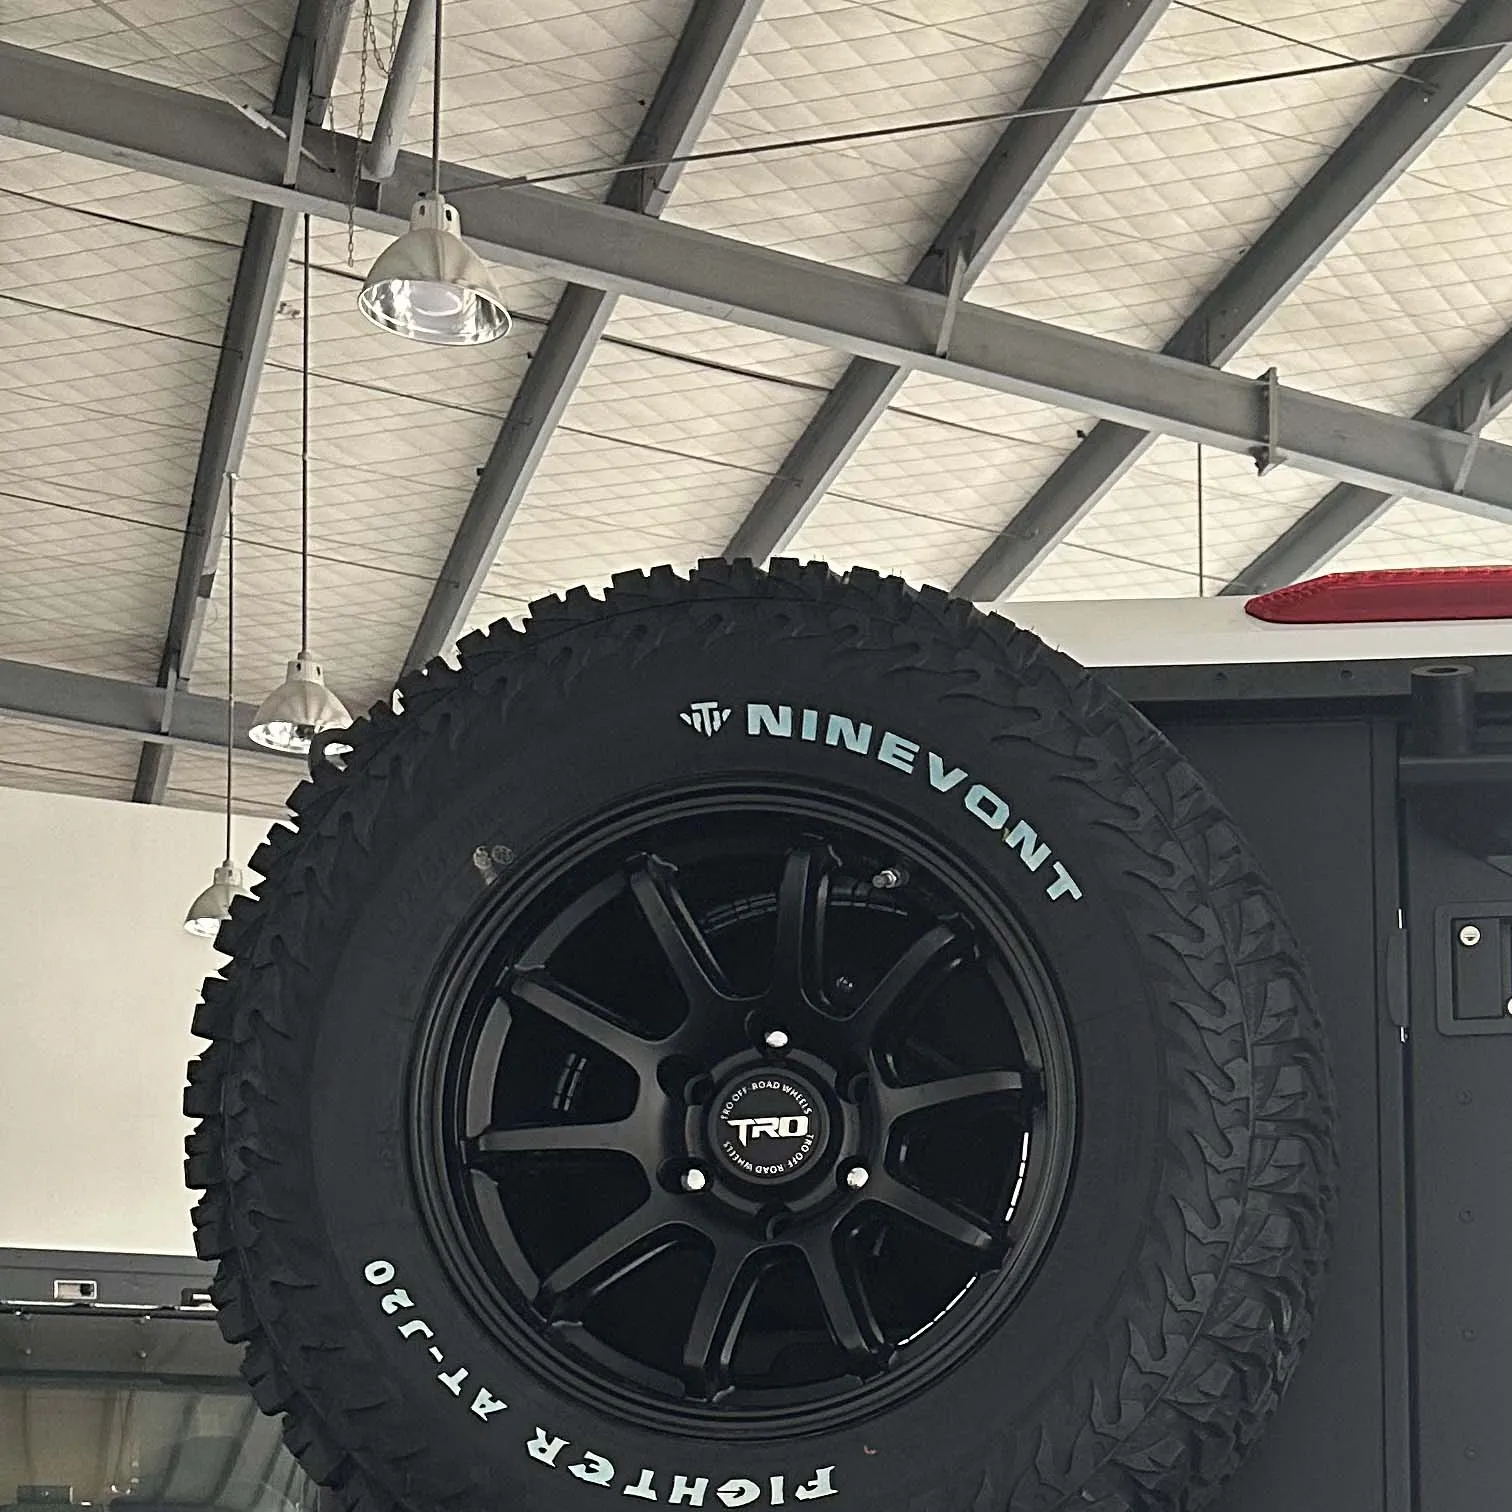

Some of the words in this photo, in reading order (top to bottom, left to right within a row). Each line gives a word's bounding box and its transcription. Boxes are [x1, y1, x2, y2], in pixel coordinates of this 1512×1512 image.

[746, 702, 1083, 901] NINEVONT
[726, 1115, 809, 1148] TRO
[364, 1259, 509, 1422] AT-J20
[526, 1426, 840, 1508] FIGHTER
